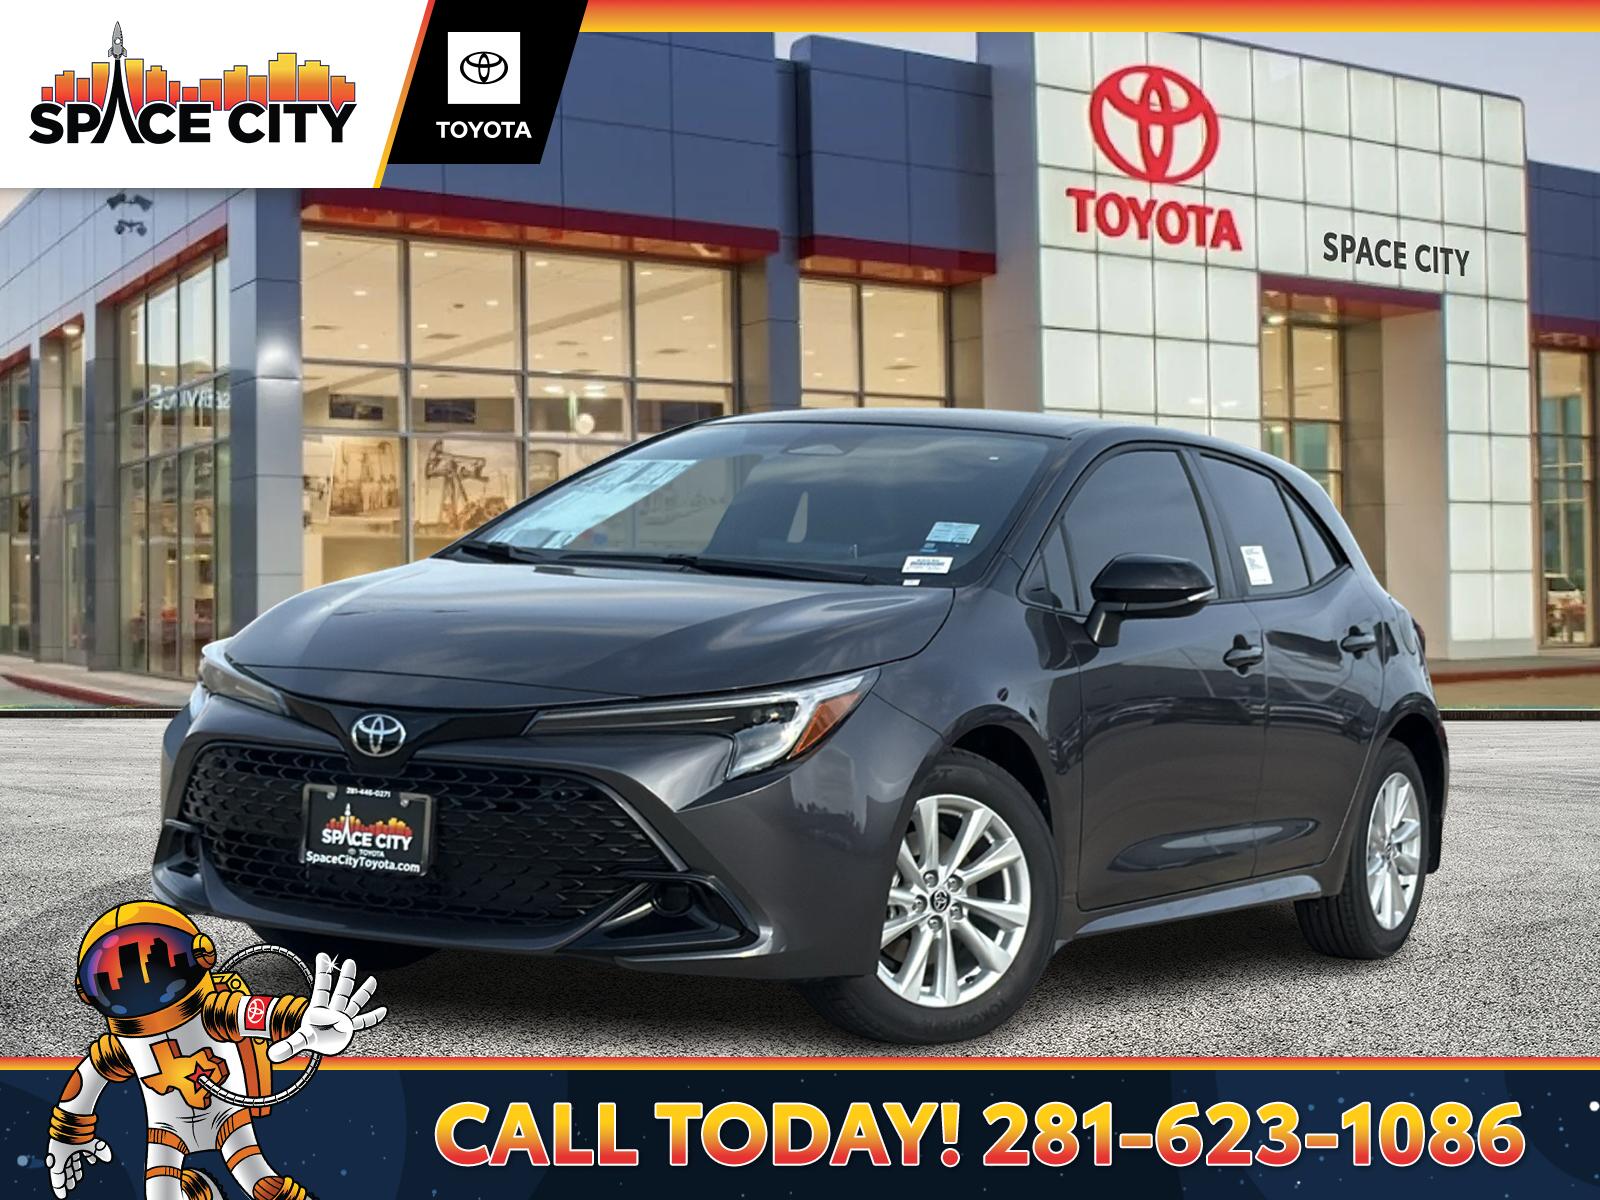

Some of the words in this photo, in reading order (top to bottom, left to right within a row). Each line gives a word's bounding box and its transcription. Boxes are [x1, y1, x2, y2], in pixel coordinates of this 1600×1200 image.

[1066, 187, 1243, 251] TOYOTA
[1322, 231, 1407, 270] SPACE
[1414, 244, 1470, 276] CITY
[359, 849, 385, 858] TOYOTA
[375, 834, 413, 851] CITY
[306, 850, 421, 873] SpaceCityToyota.com
